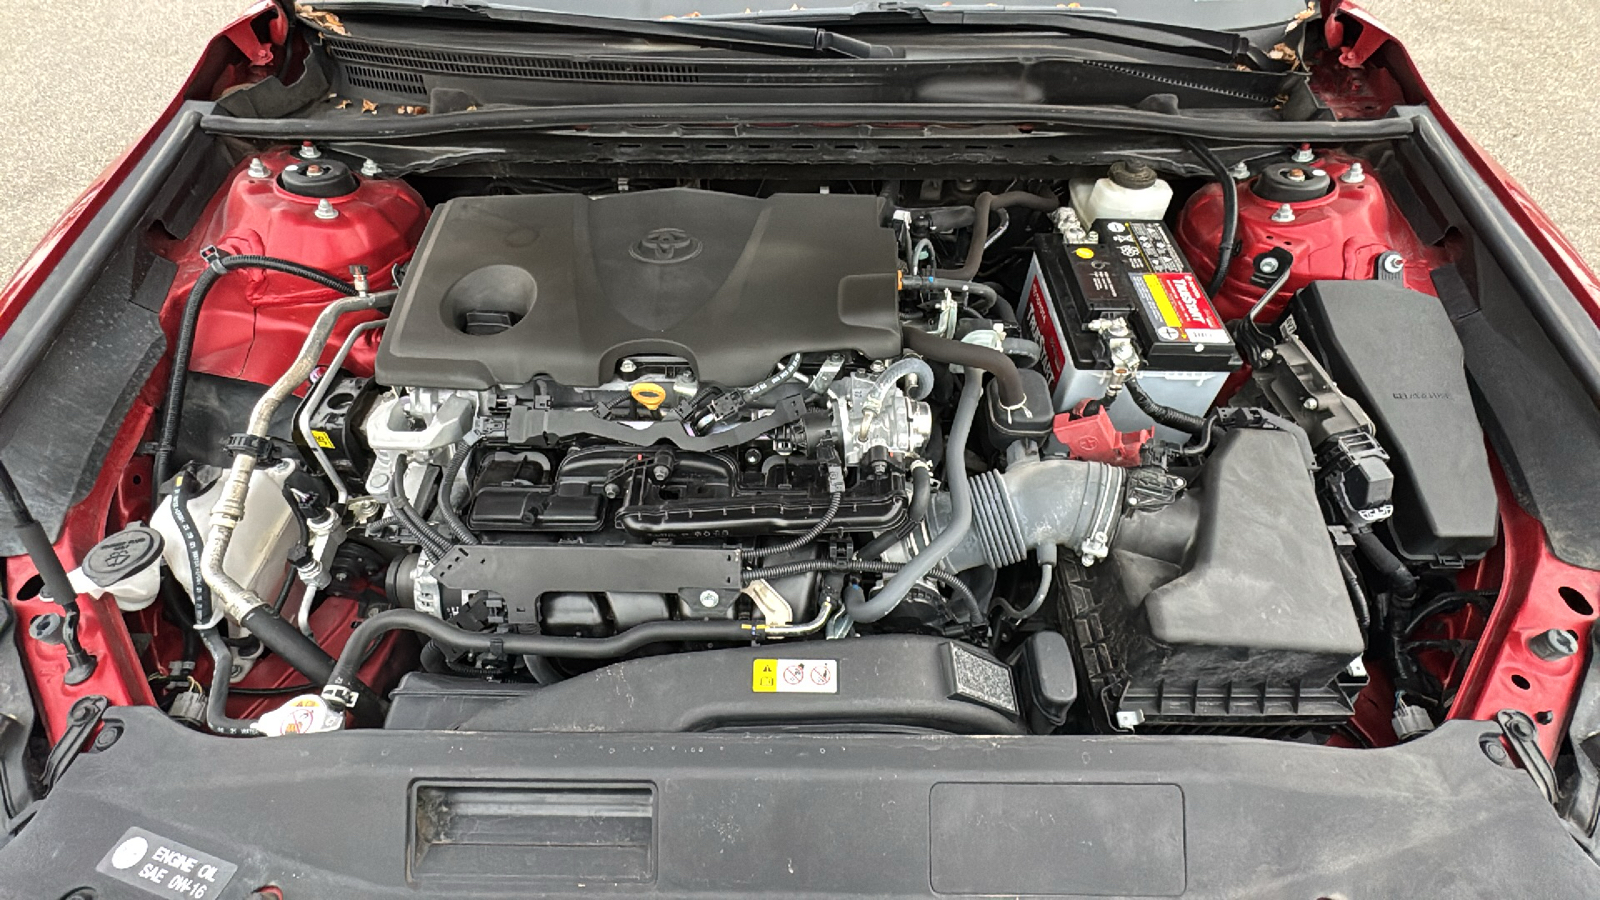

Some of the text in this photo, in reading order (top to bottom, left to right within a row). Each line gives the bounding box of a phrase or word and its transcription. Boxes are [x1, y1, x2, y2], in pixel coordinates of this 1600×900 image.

[138, 863, 208, 899] SAE 0W-16
[151, 846, 218, 883] ENGINE OIL
